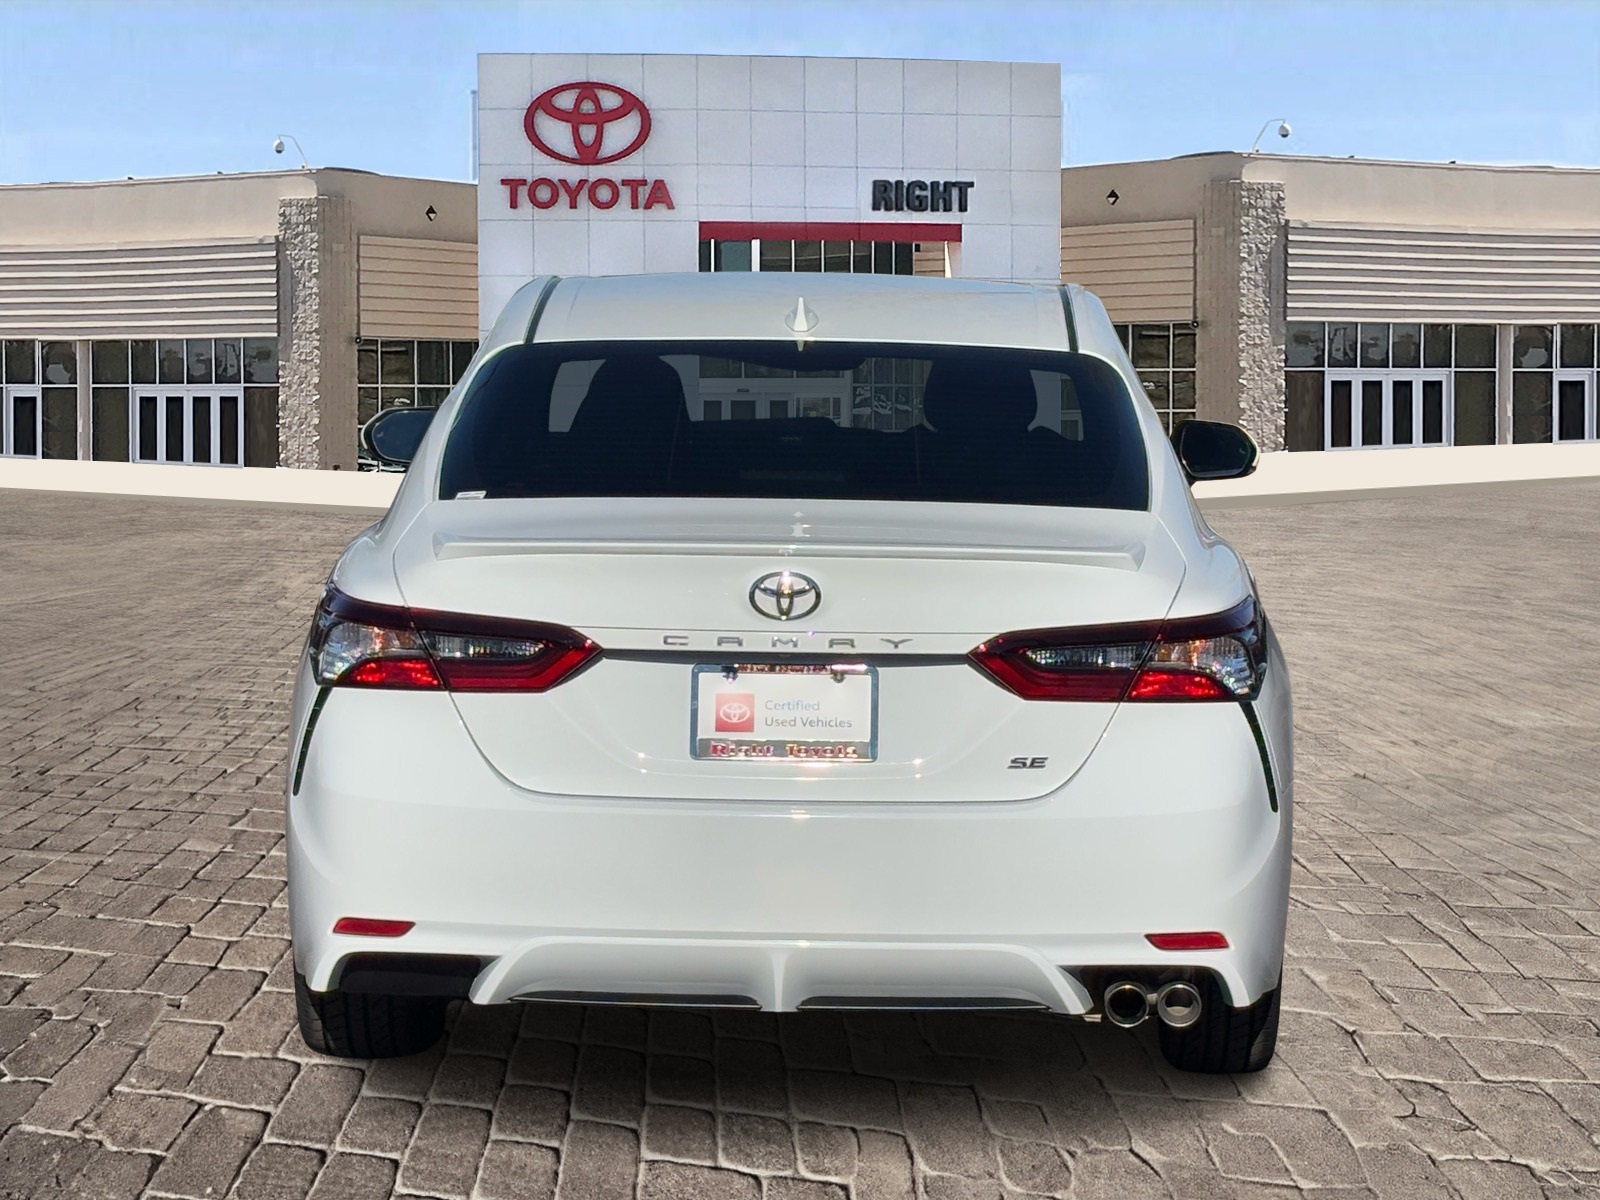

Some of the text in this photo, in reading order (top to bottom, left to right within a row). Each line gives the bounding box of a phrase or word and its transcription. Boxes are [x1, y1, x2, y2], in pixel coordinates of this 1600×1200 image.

[500, 178, 675, 210] TOYOTA
[872, 180, 975, 212] RIGHT
[663, 635, 913, 649] CAMRY
[764, 700, 820, 711] Certified
[764, 717, 853, 729] Used Vehicles
[1007, 757, 1049, 769] SE
